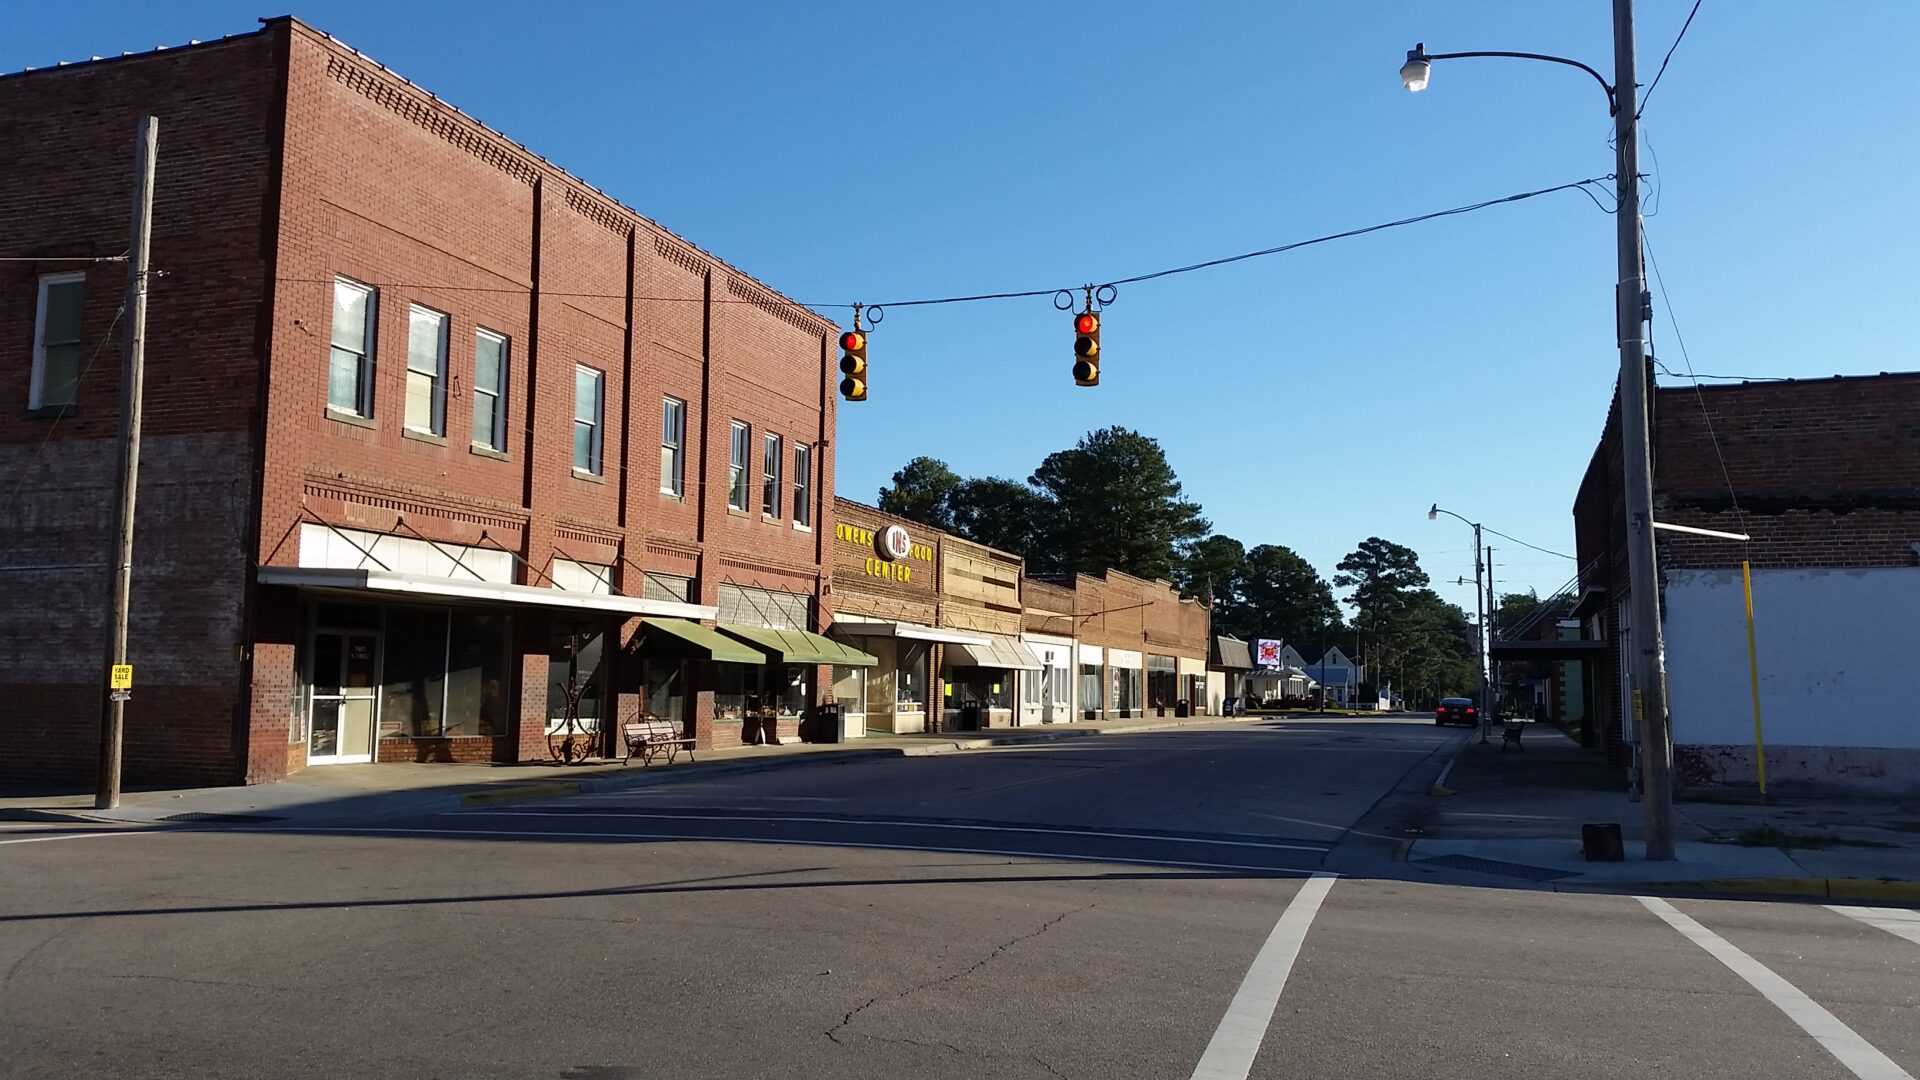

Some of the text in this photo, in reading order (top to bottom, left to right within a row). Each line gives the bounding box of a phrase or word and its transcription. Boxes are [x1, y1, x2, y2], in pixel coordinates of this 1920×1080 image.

[836, 523, 932, 562] OWENS FOOD
[865, 557, 911, 583] CENTER
